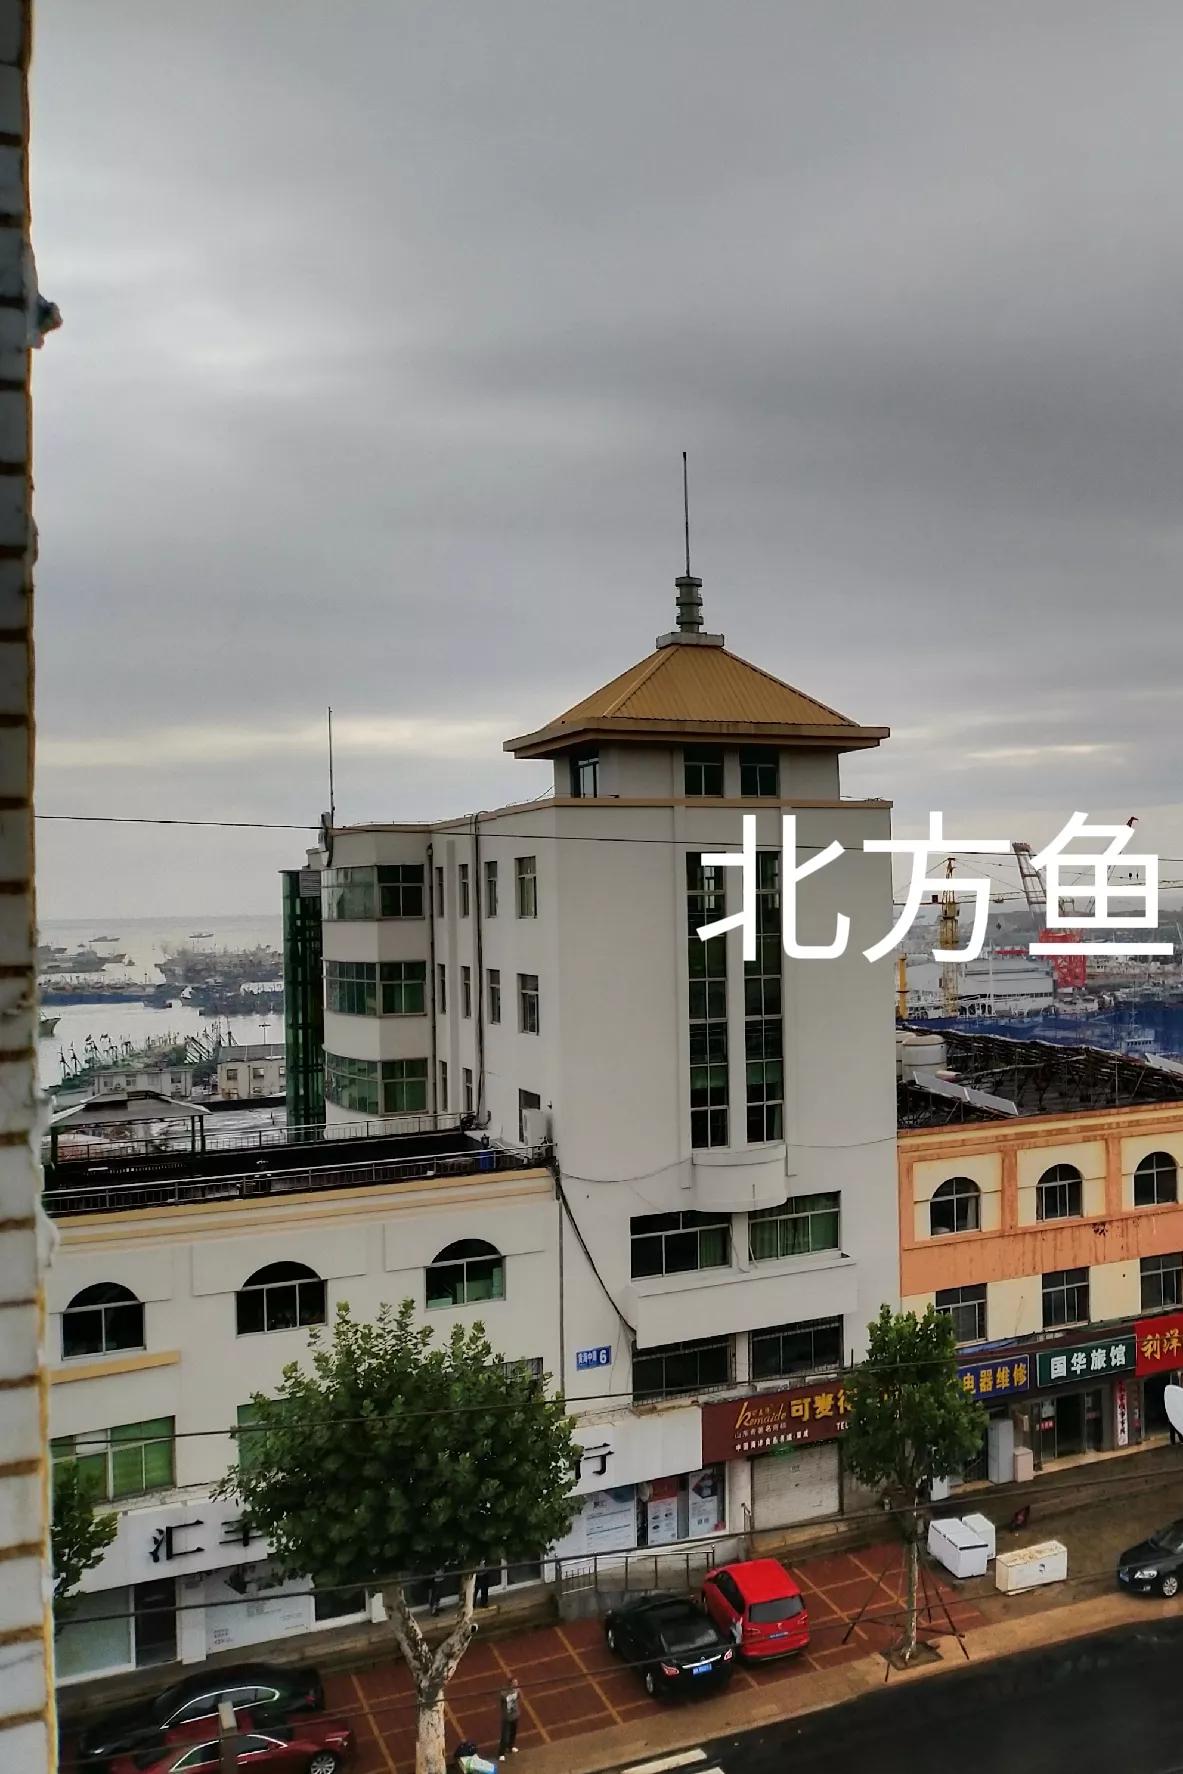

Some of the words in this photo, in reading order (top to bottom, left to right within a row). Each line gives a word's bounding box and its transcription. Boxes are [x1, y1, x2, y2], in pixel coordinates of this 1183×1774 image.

[599, 1349, 607, 1364] 6
[1050, 1344, 1126, 1380] 国华旅馆
[836, 1421, 849, 1431] TEL
